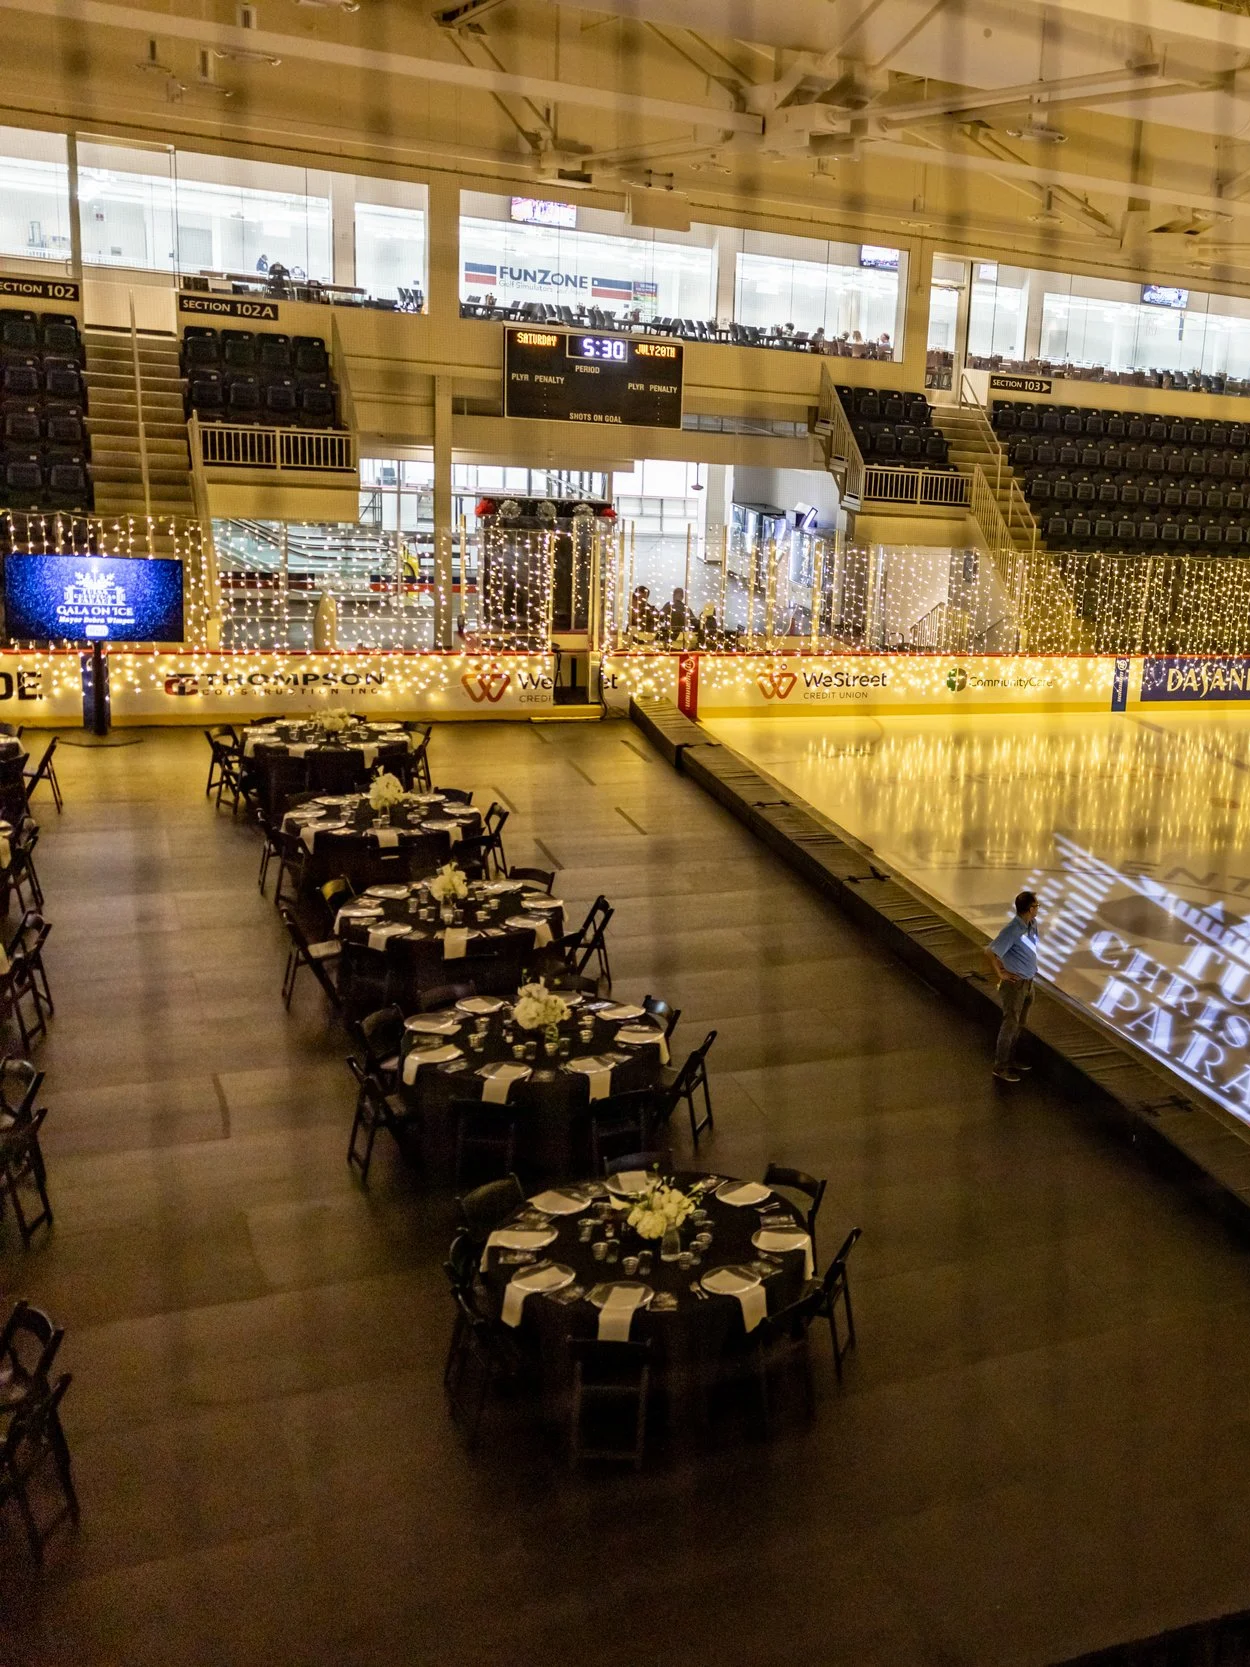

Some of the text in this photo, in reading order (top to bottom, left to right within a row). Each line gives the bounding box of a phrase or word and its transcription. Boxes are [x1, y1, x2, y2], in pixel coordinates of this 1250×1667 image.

[499, 266, 588, 290] FUNZONE
[47, 284, 75, 299] 102
[183, 299, 274, 318] SECTION 102A
[516, 332, 558, 347] SATURDAY
[582, 338, 625, 360] 5:30
[575, 365, 600, 374] PERIOD
[511, 373, 565, 385] PLYR PENALTY
[992, 379, 1041, 391] SECTION 103
[627, 382, 678, 394] PLYR PENALTY
[569, 412, 622, 423] SHOTS ON GOAL
[56, 605, 134, 616] GALA ON ICE
[201, 673, 386, 687] THOMPSON
[803, 671, 888, 688] WeStreet
[803, 691, 869, 700] CREDIT UNION
